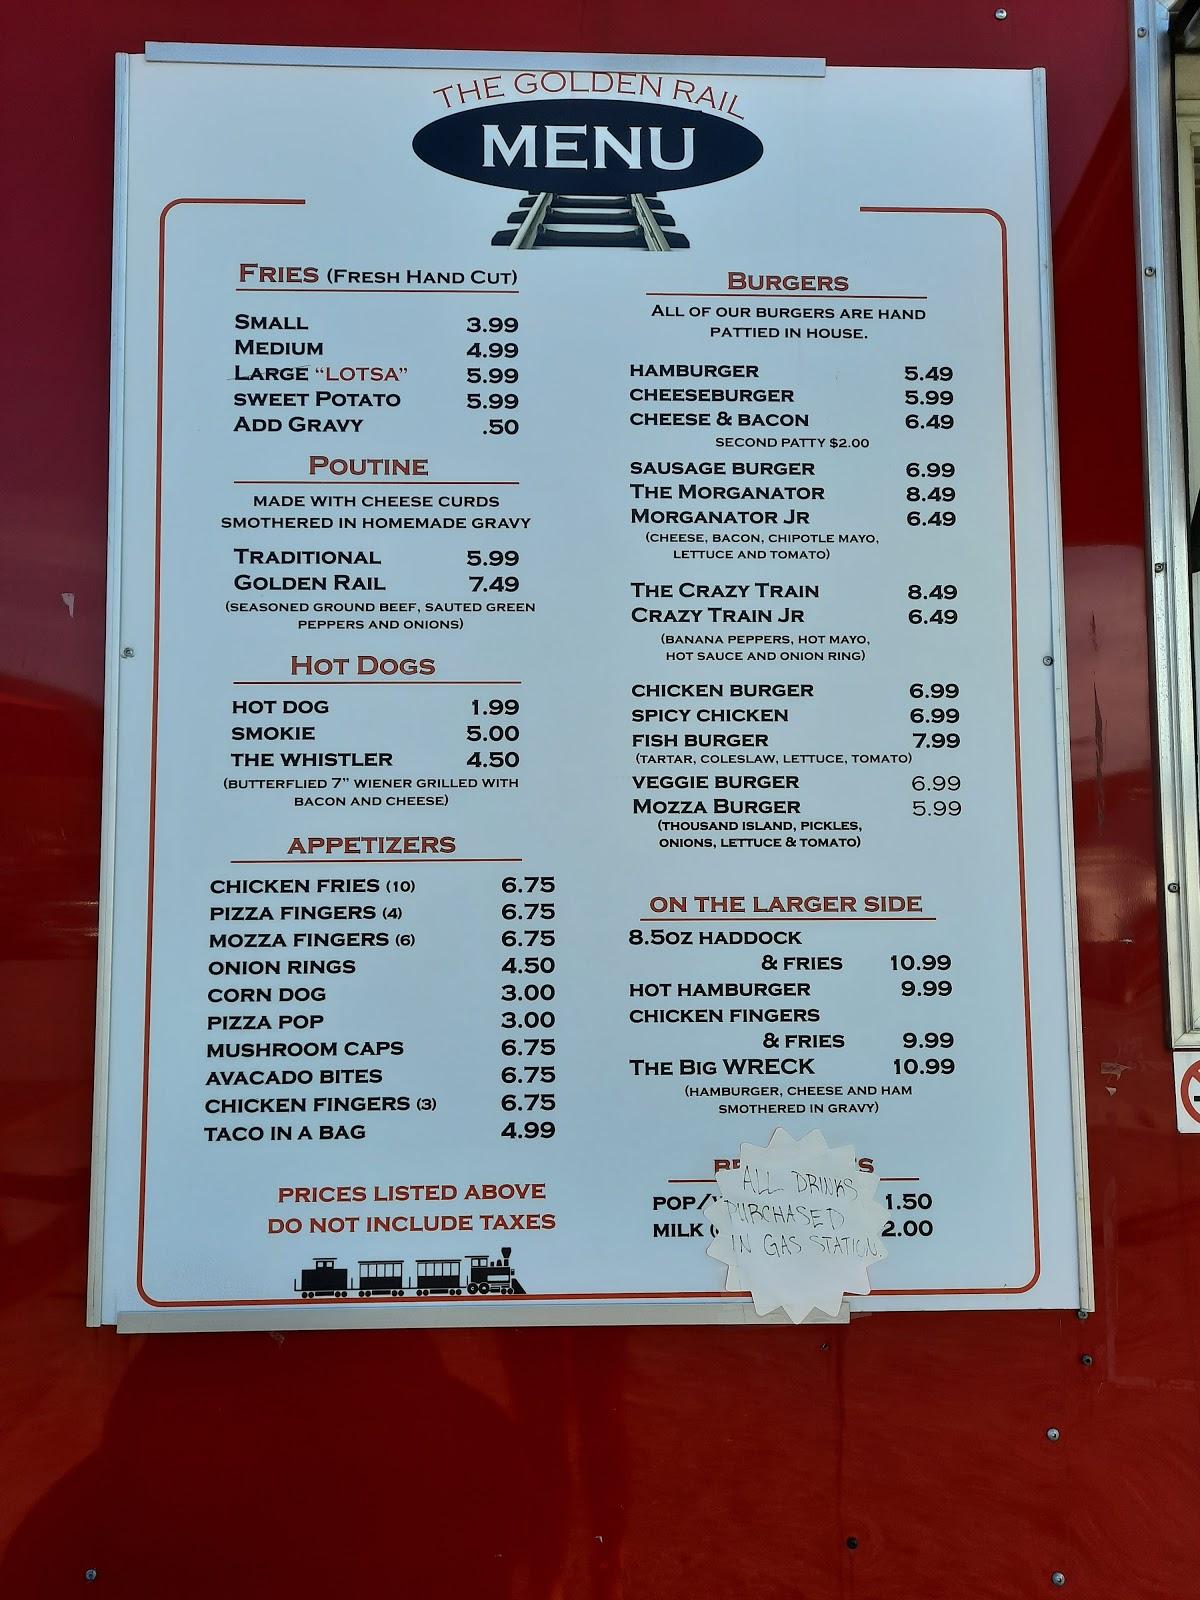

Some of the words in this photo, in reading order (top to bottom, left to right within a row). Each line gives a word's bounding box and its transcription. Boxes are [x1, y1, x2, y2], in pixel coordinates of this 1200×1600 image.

[433, 75, 505, 108] THE
[514, 71, 663, 98] GOLDEN
[672, 79, 745, 121] RAIL
[481, 124, 696, 171] MENU
[240, 263, 319, 284] FRIES
[327, 268, 400, 284] (FRESH
[407, 269, 465, 284] HAND
[470, 269, 518, 286] CUT)
[728, 272, 849, 292] BURGERS
[651, 304, 685, 317] ALL
[689, 306, 712, 317] OF
[716, 307, 751, 318] OUR
[756, 307, 835, 319] BURGERS
[839, 309, 874, 319] ARE
[878, 309, 926, 320] HAND
[710, 327, 780, 338] PATTIED
[785, 328, 801, 338] IN
[806, 328, 868, 339] HOUSE.
[234, 365, 309, 381] LARGE
[466, 367, 519, 384] 5.99
[630, 364, 759, 378] HAMBURGER
[904, 365, 953, 382] 5.49
[233, 416, 282, 432] ADD
[288, 416, 364, 432] GRAVY
[483, 419, 519, 435] .50
[630, 412, 711, 426] CHEESE
[716, 411, 732, 426] &
[738, 413, 809, 427] BACON
[905, 414, 954, 430] 6.49
[715, 437, 778, 448] SECOND
[781, 438, 826, 448] PATTY
[829, 437, 869, 449] $2.00
[309, 455, 429, 476] POUTINE
[253, 496, 305, 507] MADE
[310, 496, 356, 507] WITH
[361, 496, 433, 507] CHEESE
[438, 496, 500, 507] CURDS
[221, 517, 334, 529] SMOTHERED
[339, 517, 356, 529] IN
[362, 517, 467, 529] HOMEMADE
[471, 518, 531, 529] GRAVY
[631, 508, 778, 524] MORGANATOR
[783, 509, 810, 524] JR
[906, 511, 956, 527] 6.49
[645, 531, 708, 544] (CHEESE,
[712, 534, 764, 544] BACON,
[768, 534, 835, 543] CHIPOTLE
[838, 534, 879, 544] MAYO,
[233, 548, 382, 565] TRADITIONAL
[466, 550, 519, 567] 5.99
[225, 600, 309, 613] (SEASONED
[313, 603, 375, 612] GROUND
[379, 603, 421, 613] BEEF,
[425, 602, 482, 612] SAUTED
[486, 603, 535, 612] GREEN
[298, 620, 364, 629] PEPPERS
[367, 620, 400, 629] AND
[403, 617, 464, 630] ONIONS)
[661, 633, 724, 645] (BANANA
[728, 635, 794, 646] PEPPERS,
[798, 635, 826, 644] HOT
[829, 635, 870, 646] MAYO,
[666, 651, 694, 661] HOT
[697, 651, 743, 661] SAUCE
[747, 652, 776, 661] AND
[780, 652, 824, 661] ONION
[828, 650, 865, 661] RING)
[291, 655, 350, 675] HOT
[357, 655, 436, 675] DOGS
[231, 726, 315, 741] SMOKIE
[466, 725, 520, 742] 5.00
[632, 734, 678, 747] FISH
[684, 734, 769, 748] BURGER
[912, 732, 960, 749] 7.99
[230, 753, 274, 767] THE
[279, 752, 393, 767] WHISTLER
[466, 751, 520, 768] 4.50
[636, 752, 696, 765] (TARTAR,
[700, 754, 779, 765] COLESLAW,
[783, 754, 848, 765] LETTUCE,
[851, 752, 912, 764] TOMATO)
[223, 777, 327, 790] (BUTTERFLIED
[353, 779, 412, 788] WIENER
[416, 779, 478, 788] GRILLED
[481, 778, 519, 788] WITH
[633, 798, 708, 814] MOZZA
[713, 798, 801, 814] BURGER
[912, 800, 962, 816] 5.99
[658, 819, 739, 832] (THOUSAND
[742, 821, 796, 832] ISLAND,
[800, 821, 862, 832] PICKLES,
[286, 836, 456, 854] APPETIZERS
[210, 879, 310, 894] CHICKEN
[317, 878, 380, 893] FRIES
[386, 880, 415, 893] (10)
[501, 876, 555, 894] 6.75
[650, 896, 687, 913] ON
[694, 896, 746, 913] THE
[753, 896, 857, 913] LARGER
[864, 895, 923, 913] SIDE
[699, 931, 803, 945] HADDOCK
[208, 960, 281, 976] ONION
[287, 960, 356, 975] RINGS
[501, 956, 555, 974] 4.50
[761, 954, 778, 971] &
[783, 956, 843, 970] FRIES
[890, 954, 951, 971] 10.99
[207, 1015, 272, 1030] PIZZA
[278, 1015, 324, 1029] POP
[501, 1011, 555, 1029] 3.00
[762, 1032, 779, 1049] &
[785, 1034, 845, 1048] FRIES
[903, 1032, 954, 1049] 9.99
[501, 1065, 556, 1084] 6.75
[629, 1059, 673, 1076] THE
[679, 1059, 717, 1075] BIG
[722, 1058, 815, 1075] WRECK
[893, 1058, 955, 1075] 10.99
[205, 1070, 313, 1086] AVACADO
[320, 1068, 383, 1084] BITES
[685, 1085, 783, 1098] (HAMBURGER,
[787, 1086, 843, 1096] CHEESE
[847, 1086, 877, 1095] AND
[881, 1086, 912, 1095] HAM
[719, 1104, 806, 1114] SMOTHERED
[810, 1104, 824, 1113] IN
[828, 1101, 879, 1114] GRAVY)
[203, 1126, 264, 1142] TACO
[270, 1126, 292, 1141] IN
[297, 1126, 313, 1140] A
[319, 1124, 366, 1140] BAG
[501, 1121, 556, 1139] 4.99
[743, 1165, 784, 1195] ALL
[791, 1170, 859, 1200] DRINKS
[278, 1186, 367, 1203] PRICES
[374, 1184, 457, 1202] LISTED
[464, 1183, 546, 1200] ABOVE
[885, 1193, 933, 1210] 1.50
[268, 1218, 302, 1234] DO
[309, 1217, 360, 1233] NOT
[366, 1215, 473, 1232] INCLUDE
[479, 1213, 556, 1230] TAXES
[724, 1200, 845, 1230] PURCHASED
[653, 1223, 705, 1238] MILK
[881, 1220, 934, 1237] 2.00
[731, 1233, 752, 1254] IN
[763, 1234, 802, 1258] GAS
